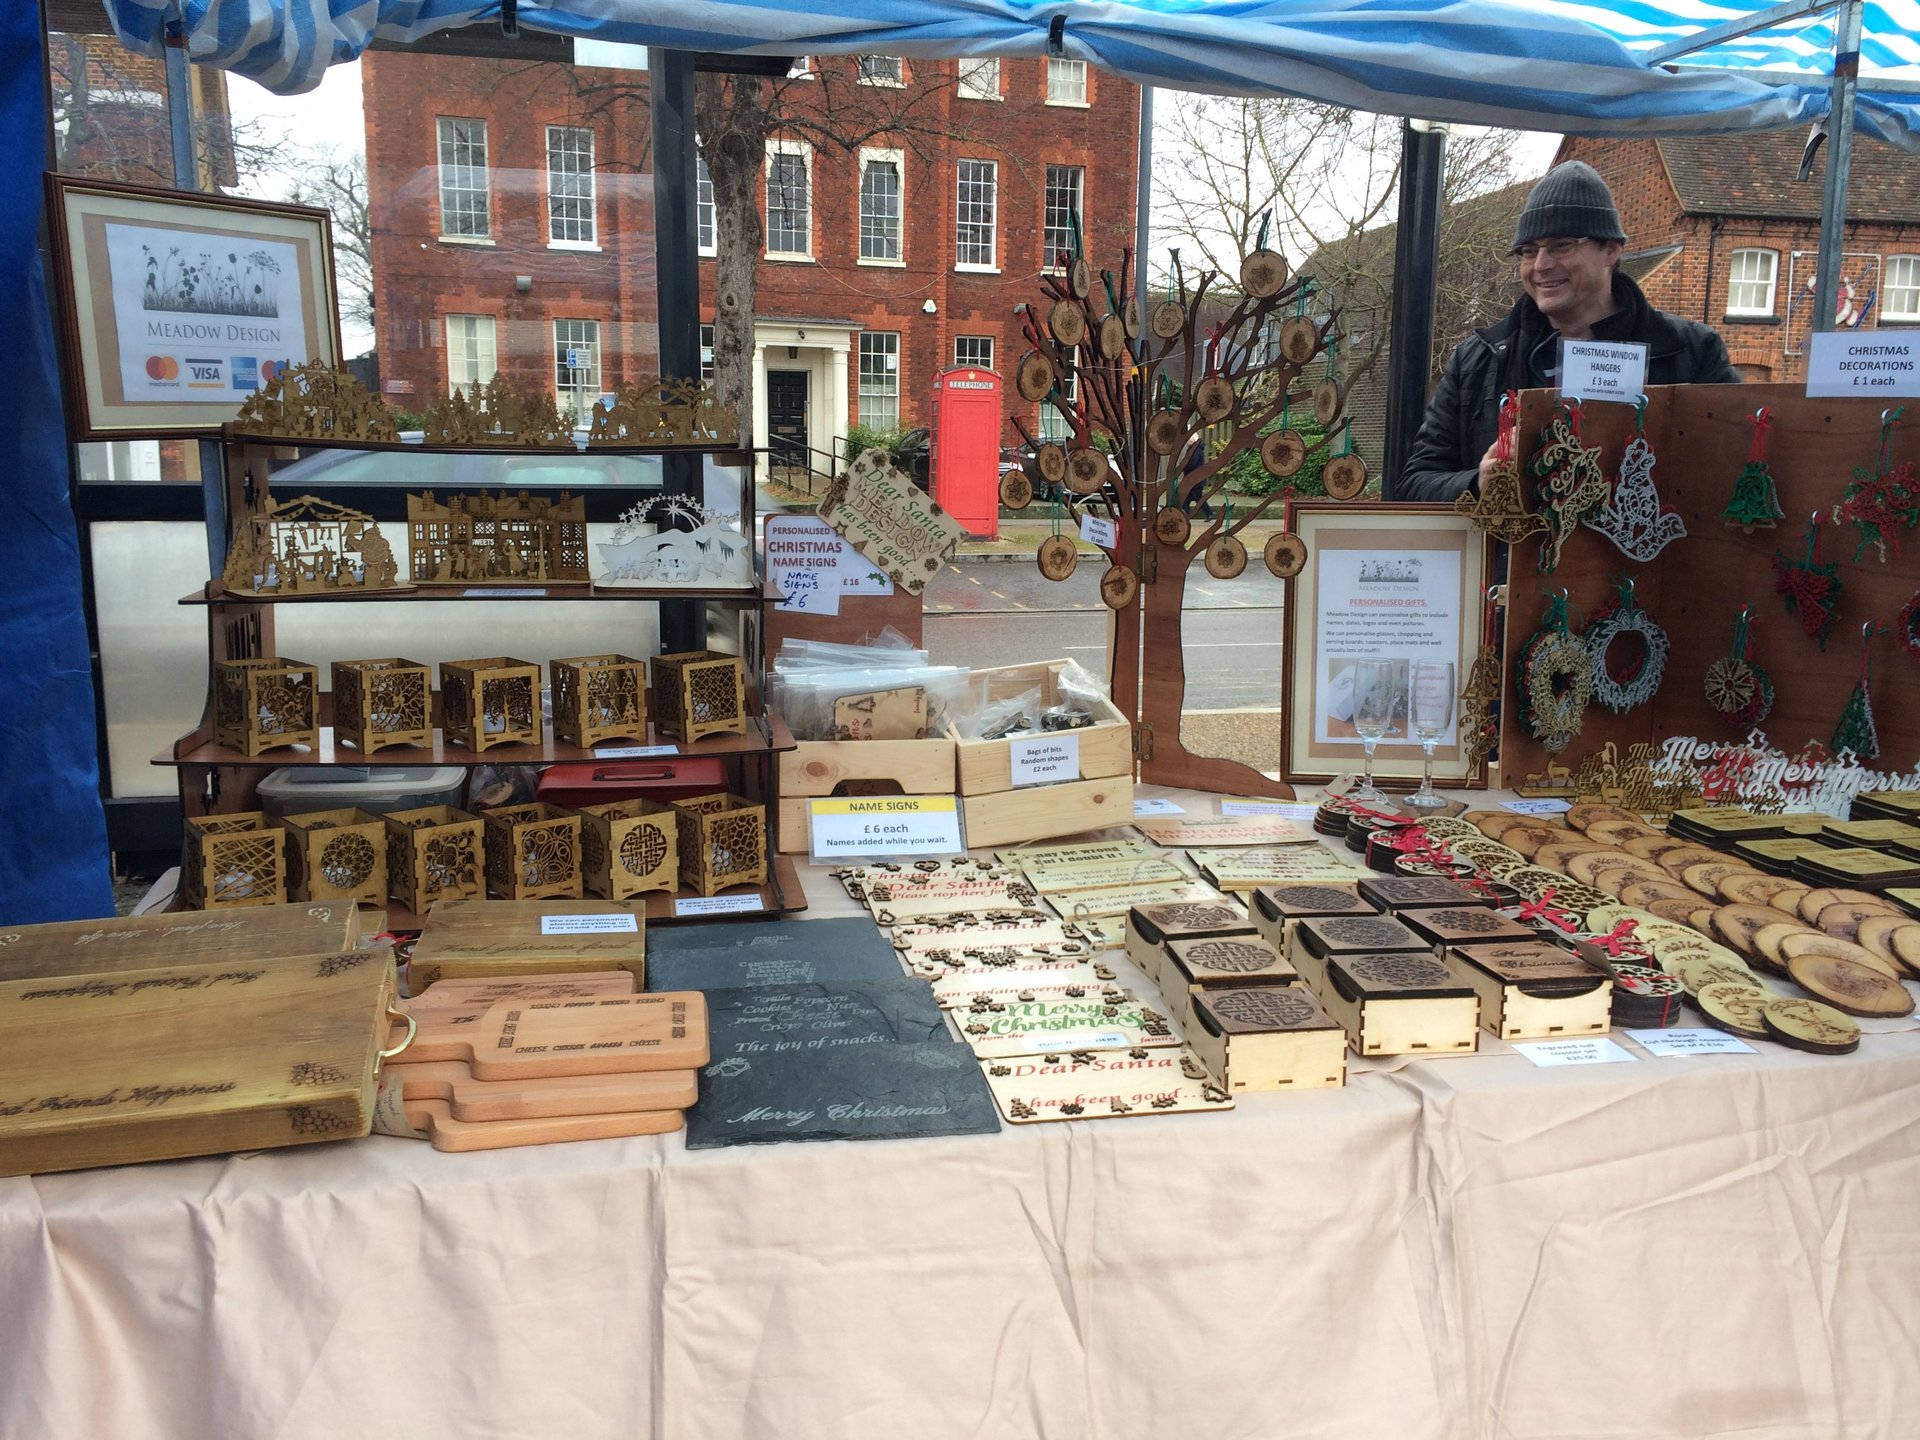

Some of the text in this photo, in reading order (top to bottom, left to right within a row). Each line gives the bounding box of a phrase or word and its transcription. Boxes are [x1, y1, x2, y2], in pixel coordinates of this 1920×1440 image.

[147, 321, 281, 342] MEADOW DESIGN
[1572, 346, 1640, 360] CHRISTMAS WINDOW
[1848, 346, 1910, 356] CHRISTMAS
[1590, 362, 1621, 373] HANGERS
[1839, 361, 1914, 371] DECORATIONS
[190, 367, 220, 380] VISA
[1592, 377, 1618, 387] £ 3 each
[1853, 376, 1895, 386] £ 1 each
[865, 467, 947, 539] Dear Santa
[854, 477, 943, 553] MEADOW
[836, 503, 883, 544] has been
[850, 493, 925, 561] DESIGN
[772, 527, 830, 535] PERSONALISED
[472, 538, 495, 546] SWEETS
[769, 541, 842, 553] CHRISTMAS
[773, 558, 837, 567] NAME SIGNS
[787, 572, 819, 581] NAME
[784, 580, 819, 589] SIGNS
[799, 594, 808, 608] 6
[1021, 757, 1047, 765] Random
[850, 801, 919, 812] NAME SIGNS
[864, 824, 909, 834] £ 6 each
[885, 837, 908, 845] while
[910, 838, 925, 846] you
[927, 836, 948, 844] wait.
[866, 871, 949, 881] Christmas
[887, 880, 1005, 892] Dear Santa
[891, 892, 928, 900] Please
[932, 890, 958, 899] stop
[984, 889, 1007, 897] for
[915, 922, 1042, 936] Dear Santa
[940, 962, 1076, 976] Dear Santa
[966, 987, 1019, 996] explain
[1024, 983, 1102, 993] everything
[1005, 1002, 1101, 1018] Merry
[991, 1009, 1145, 1035] Christmas
[735, 1042, 772, 1053] The
[775, 1039, 802, 1053] joy
[807, 1036, 829, 1049] of
[978, 1035, 1006, 1043] from
[1140, 1036, 1176, 1044] family
[515, 1039, 662, 1054] CHEESE CHEESE
[1014, 1058, 1174, 1077] Dear Santa
[1029, 1094, 1122, 1109] has been
[726, 1102, 952, 1127] Merry Christmas
